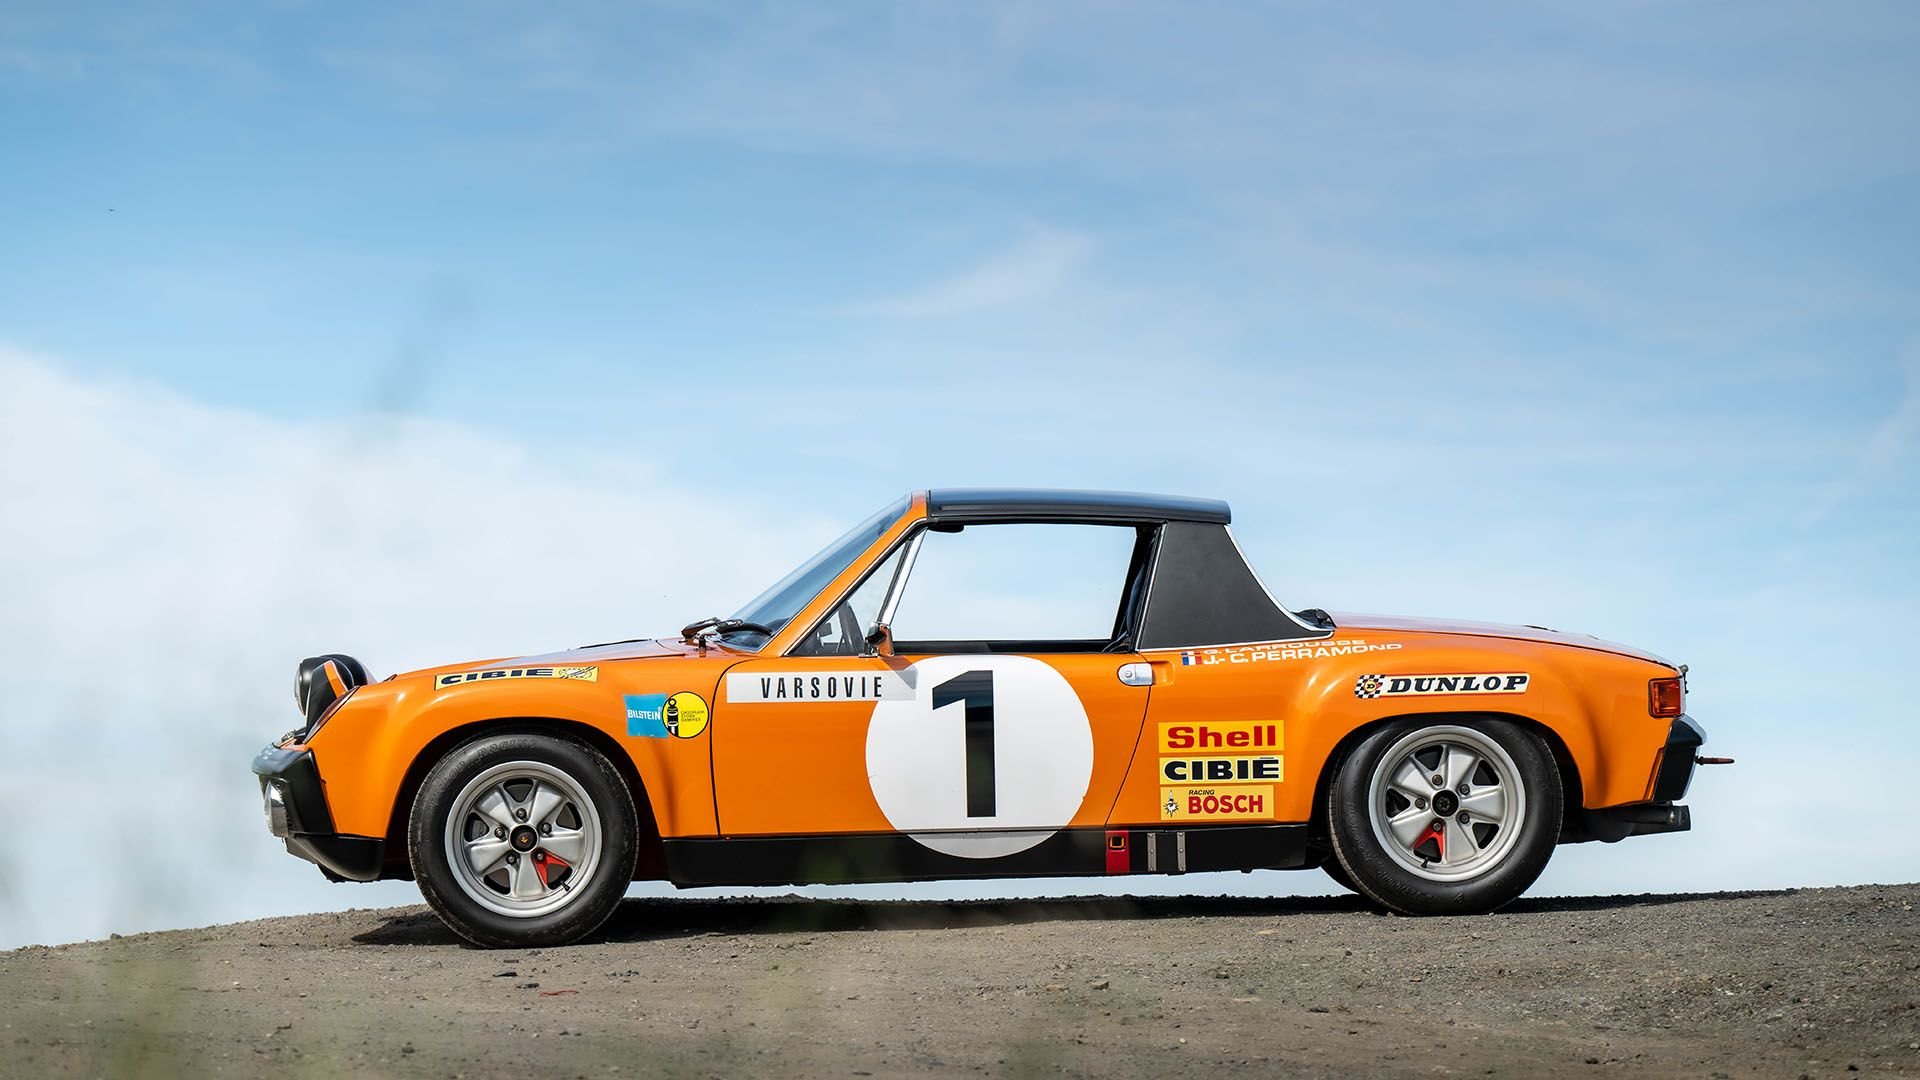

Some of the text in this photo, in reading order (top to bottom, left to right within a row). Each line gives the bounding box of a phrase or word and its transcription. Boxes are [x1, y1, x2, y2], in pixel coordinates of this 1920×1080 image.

[1252, 643, 1402, 662] PERRAMOND
[761, 676, 882, 698] VARSOVIE
[1387, 675, 1528, 693] DUNLOP
[627, 709, 661, 720] BILSTEIN
[932, 670, 996, 817] 1
[1167, 725, 1276, 749] Shell
[1188, 795, 1263, 814] BOSCH
